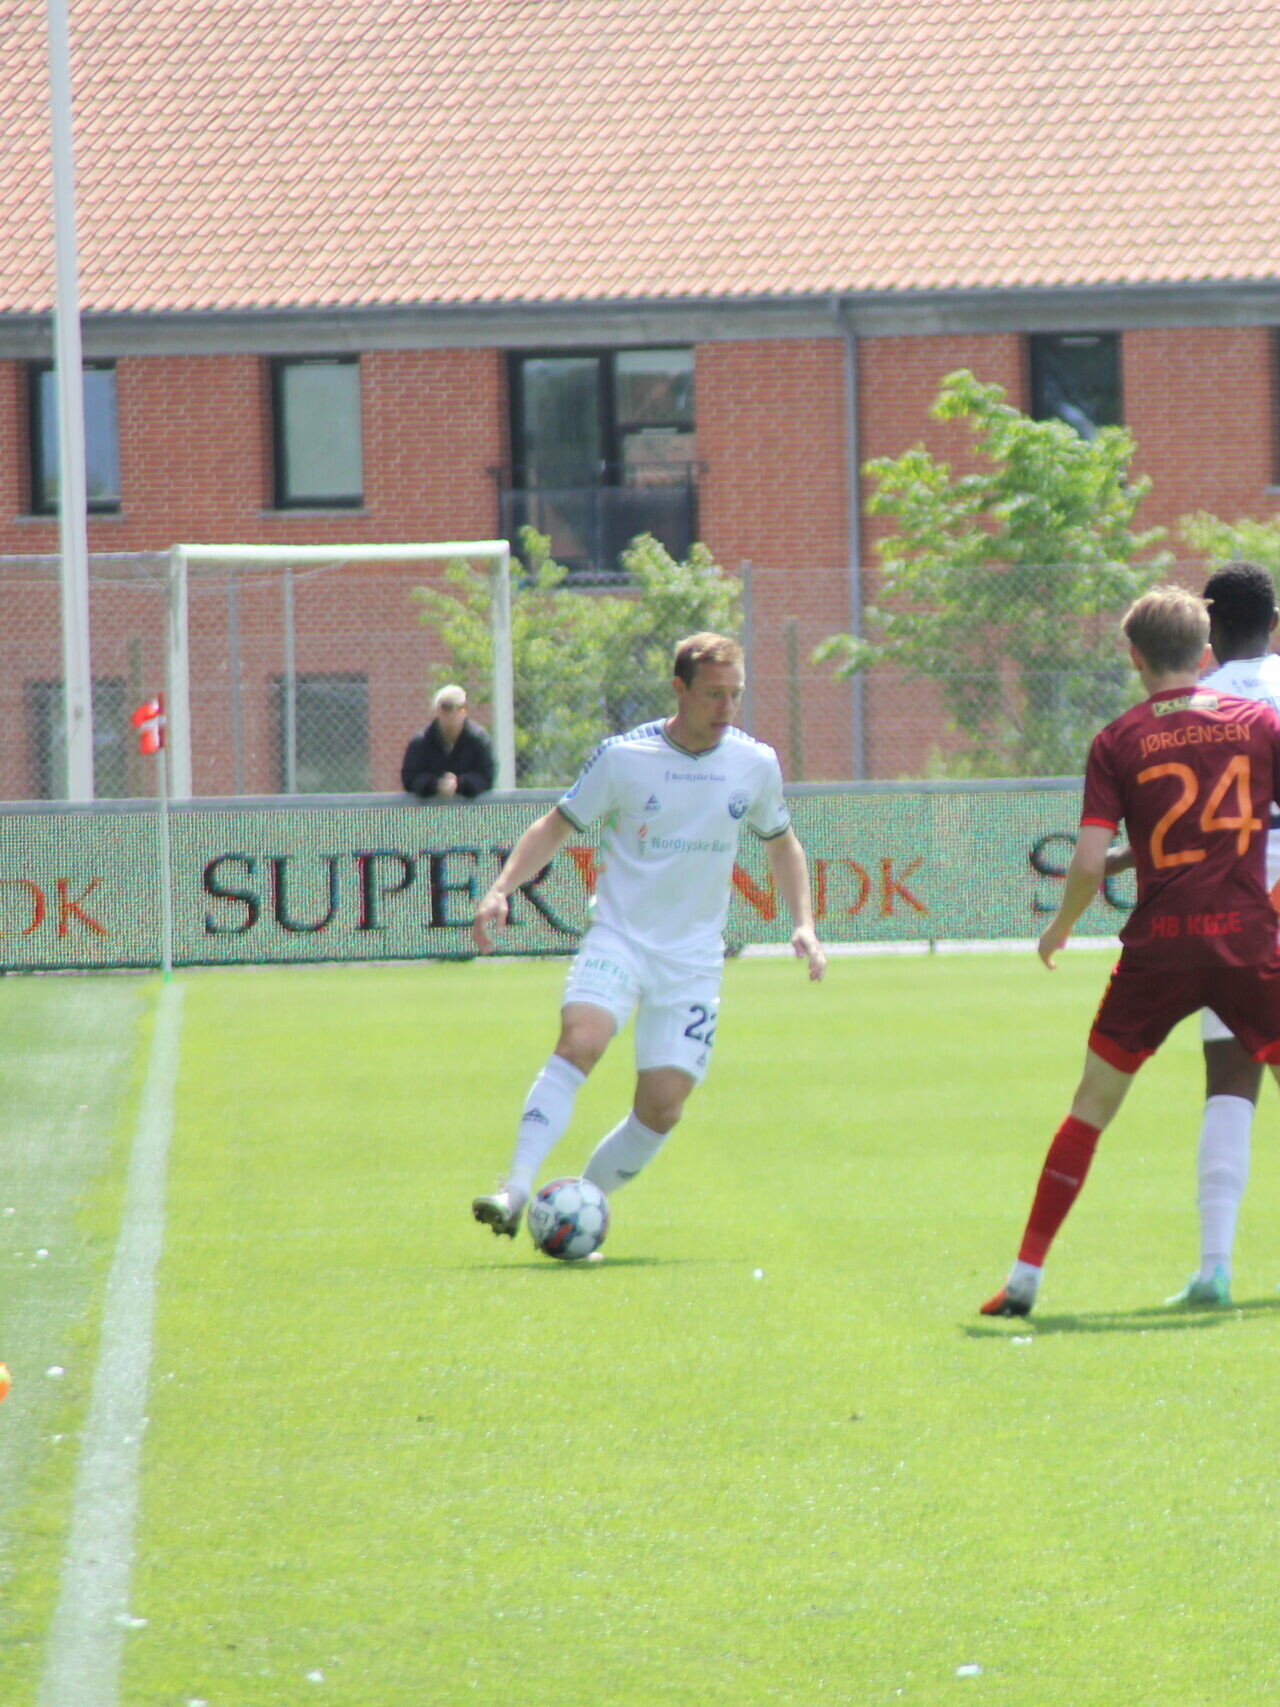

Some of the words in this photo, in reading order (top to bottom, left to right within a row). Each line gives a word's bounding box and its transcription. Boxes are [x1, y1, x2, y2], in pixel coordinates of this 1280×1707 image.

[1139, 723, 1250, 758] JØRGENSEN
[1137, 754, 1262, 870] 24
[651, 835, 710, 854] Nordjyske
[1151, 914, 1182, 938] HB
